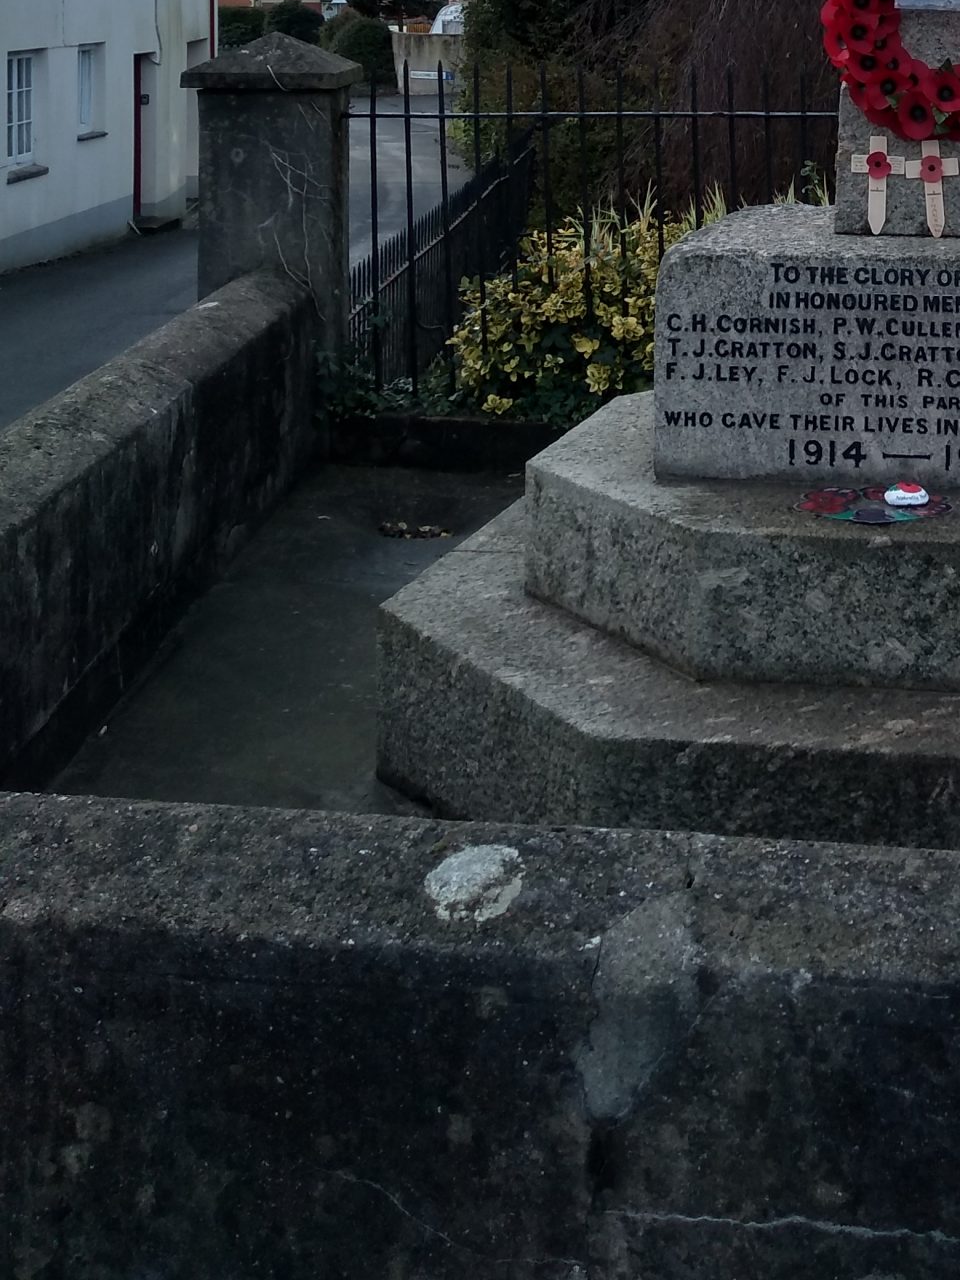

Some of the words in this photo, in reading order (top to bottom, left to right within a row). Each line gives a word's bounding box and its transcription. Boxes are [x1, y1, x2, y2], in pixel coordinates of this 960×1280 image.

[806, 266, 848, 286] THE
[769, 292, 790, 309] IN
[796, 292, 918, 312] HONOURED
[819, 393, 846, 407] OF
[861, 394, 907, 409] THIS
[664, 411, 713, 427] WHO
[790, 414, 855, 432] THEIR
[864, 416, 928, 435] LIVES
[937, 418, 958, 436] IN
[789, 439, 867, 468] 1914
